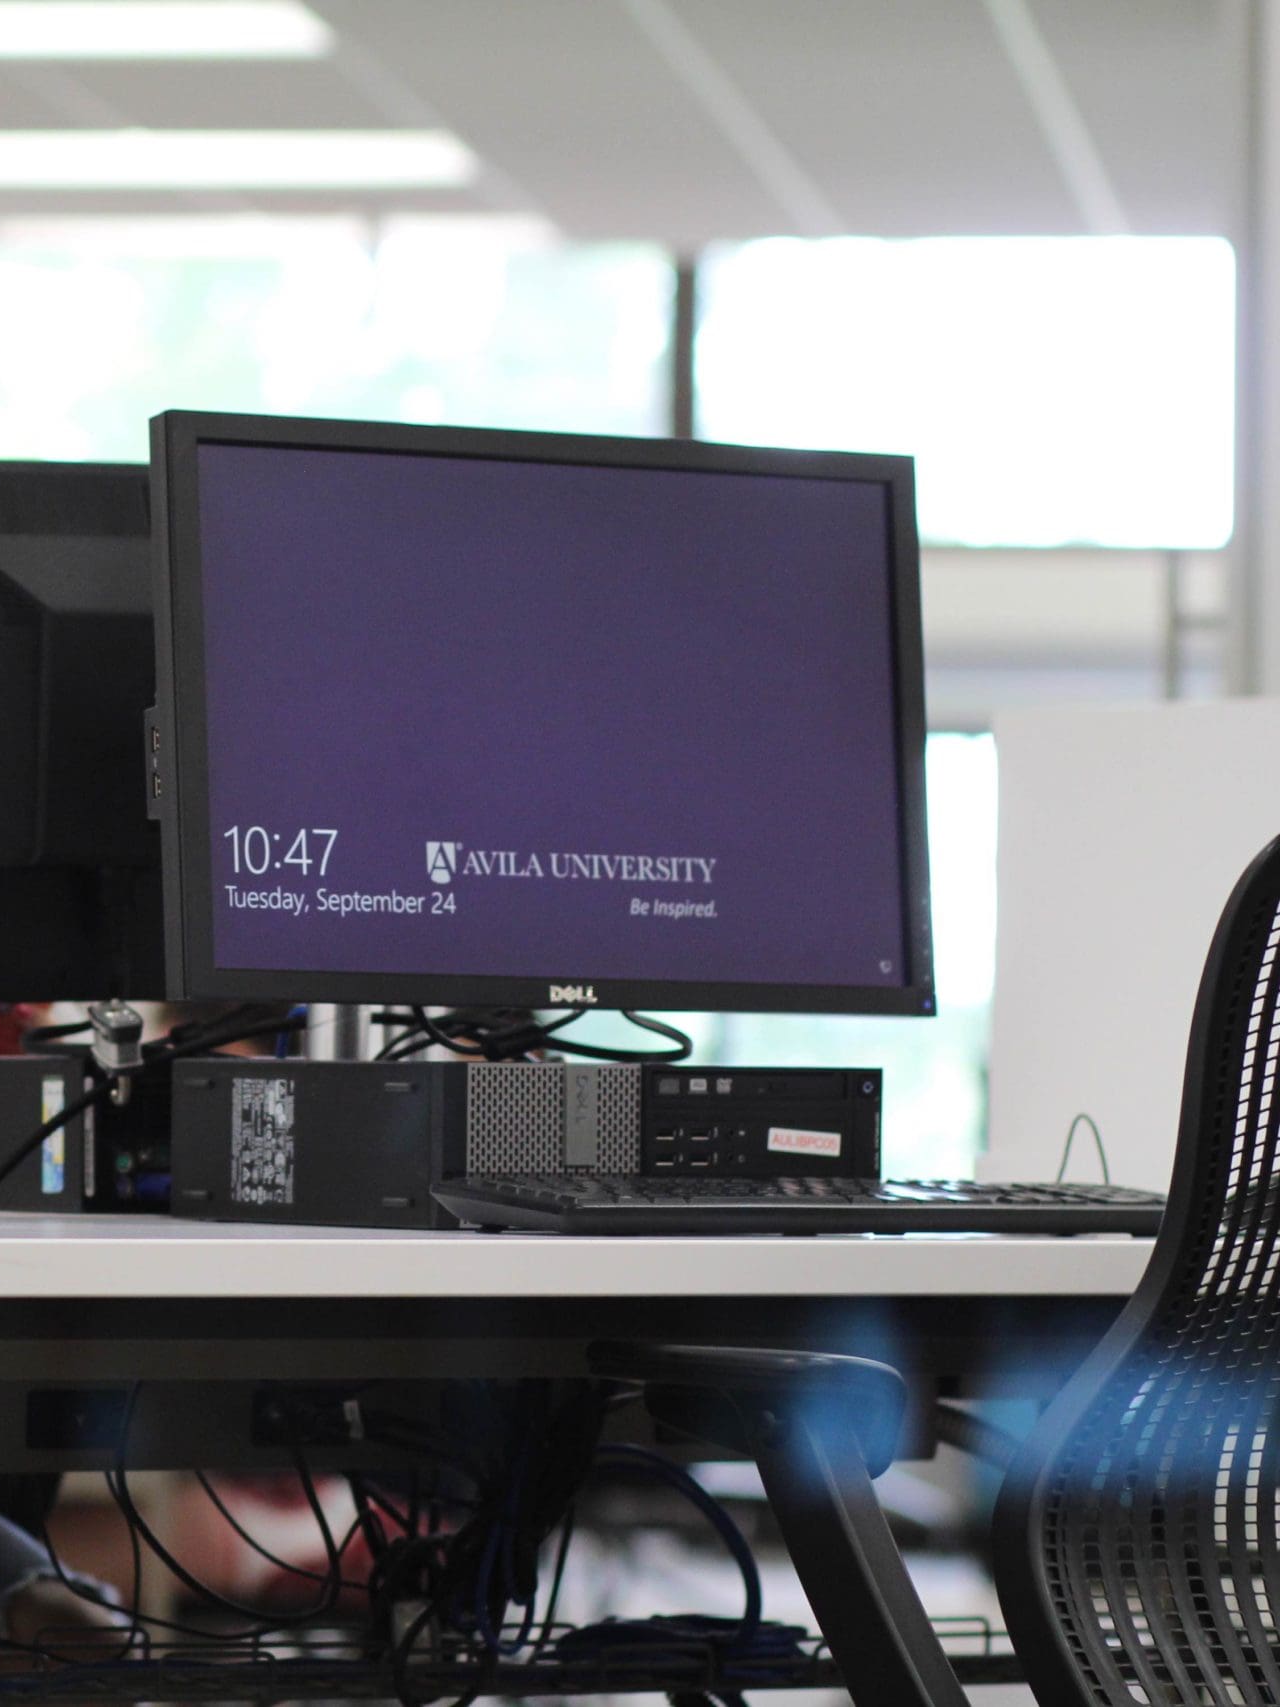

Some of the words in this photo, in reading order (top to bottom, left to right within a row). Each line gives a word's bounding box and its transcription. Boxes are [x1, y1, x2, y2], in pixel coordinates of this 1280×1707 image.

[223, 825, 339, 876] 10:47
[463, 850, 544, 878] AVILA
[550, 852, 717, 883] UNIVERSITY
[224, 885, 310, 916] Tuesday,
[316, 888, 426, 917] September
[430, 891, 457, 915] 24
[630, 898, 649, 915] Be
[653, 899, 718, 919] Inspired.
[550, 984, 598, 1003] DELL
